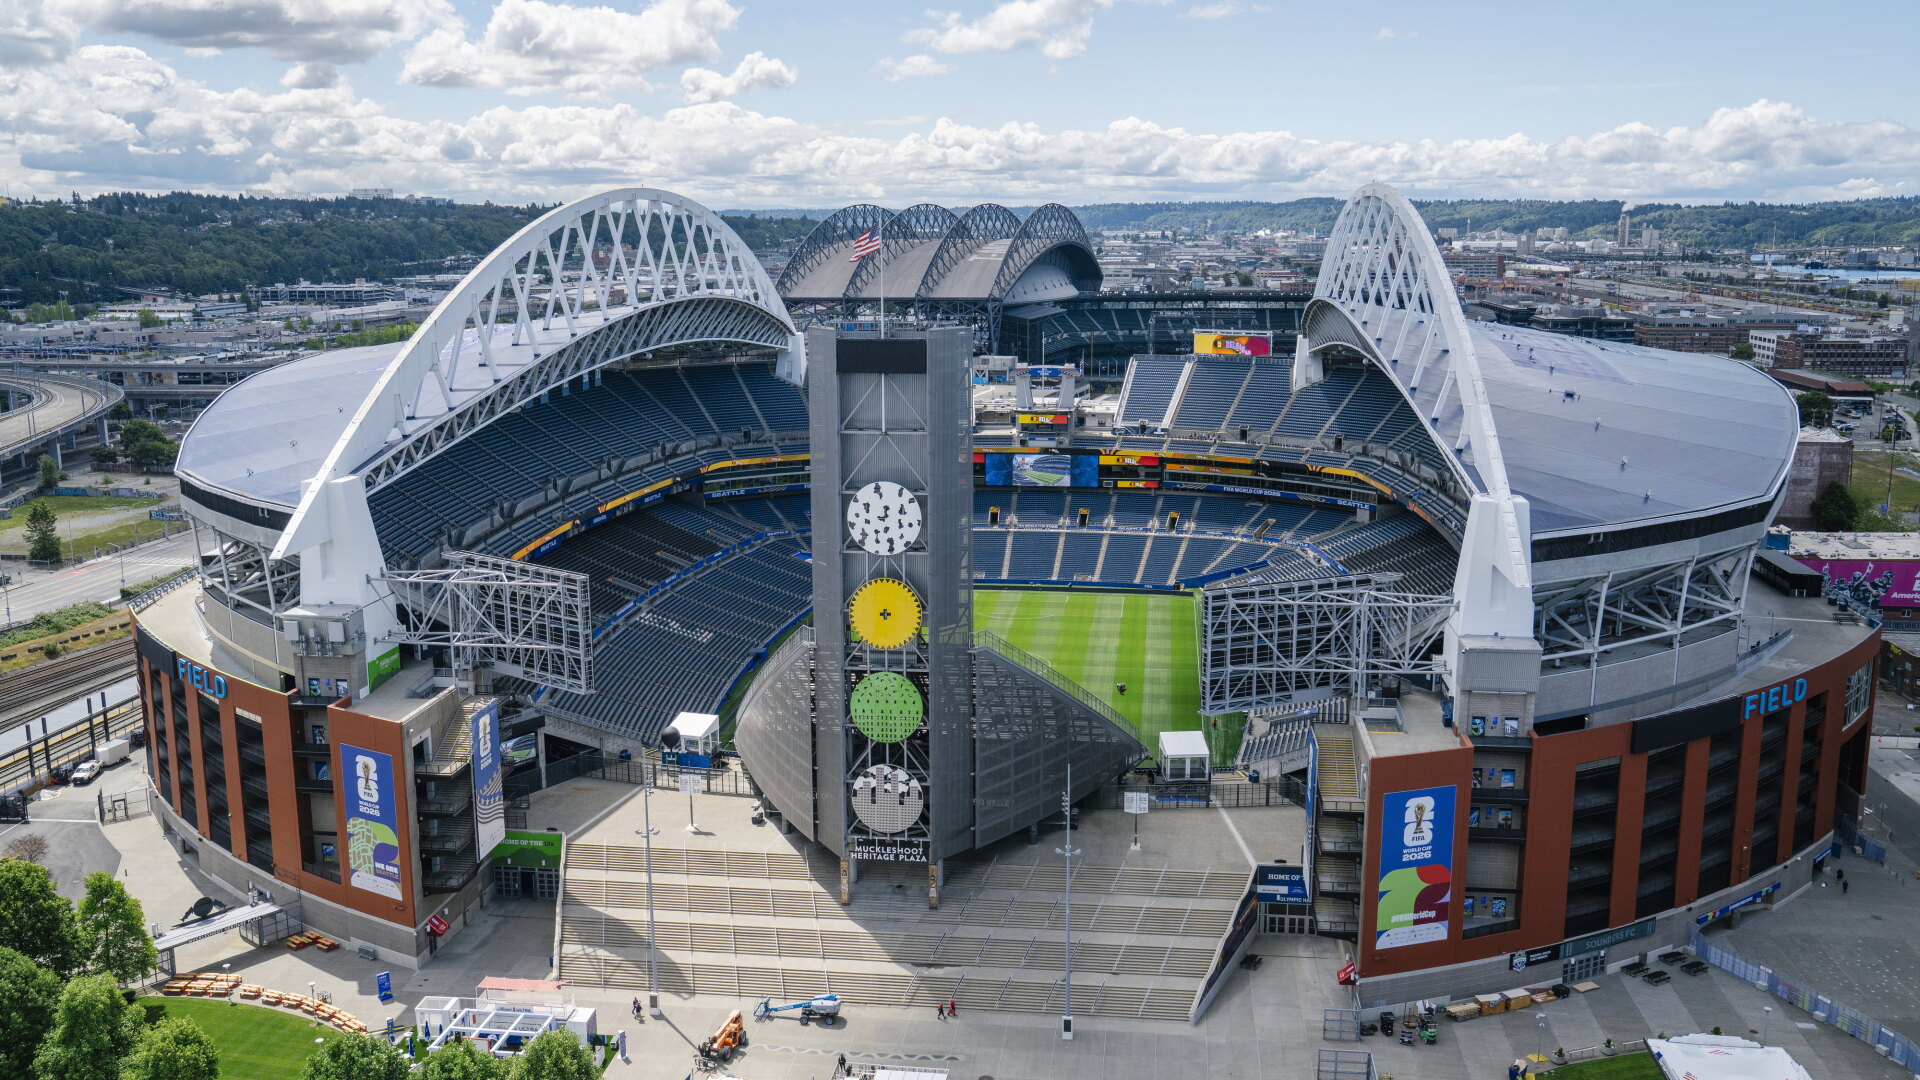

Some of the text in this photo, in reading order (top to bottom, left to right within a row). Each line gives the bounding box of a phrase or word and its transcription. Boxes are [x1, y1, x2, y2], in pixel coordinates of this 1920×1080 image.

[711, 489, 746, 498] SEATTLE
[1337, 499, 1370, 510] SEATTLE
[178, 658, 227, 699] FIELD
[1744, 678, 1807, 720] FIELD
[363, 791, 374, 799] FIFA
[359, 806, 380, 816] 2026
[855, 846, 923, 855] MUCKLESHOOT
[851, 852, 927, 862] HERITAGE PLAZA
[1402, 851, 1432, 862] 2026
[1585, 928, 1636, 949] SOUNDERS FC
